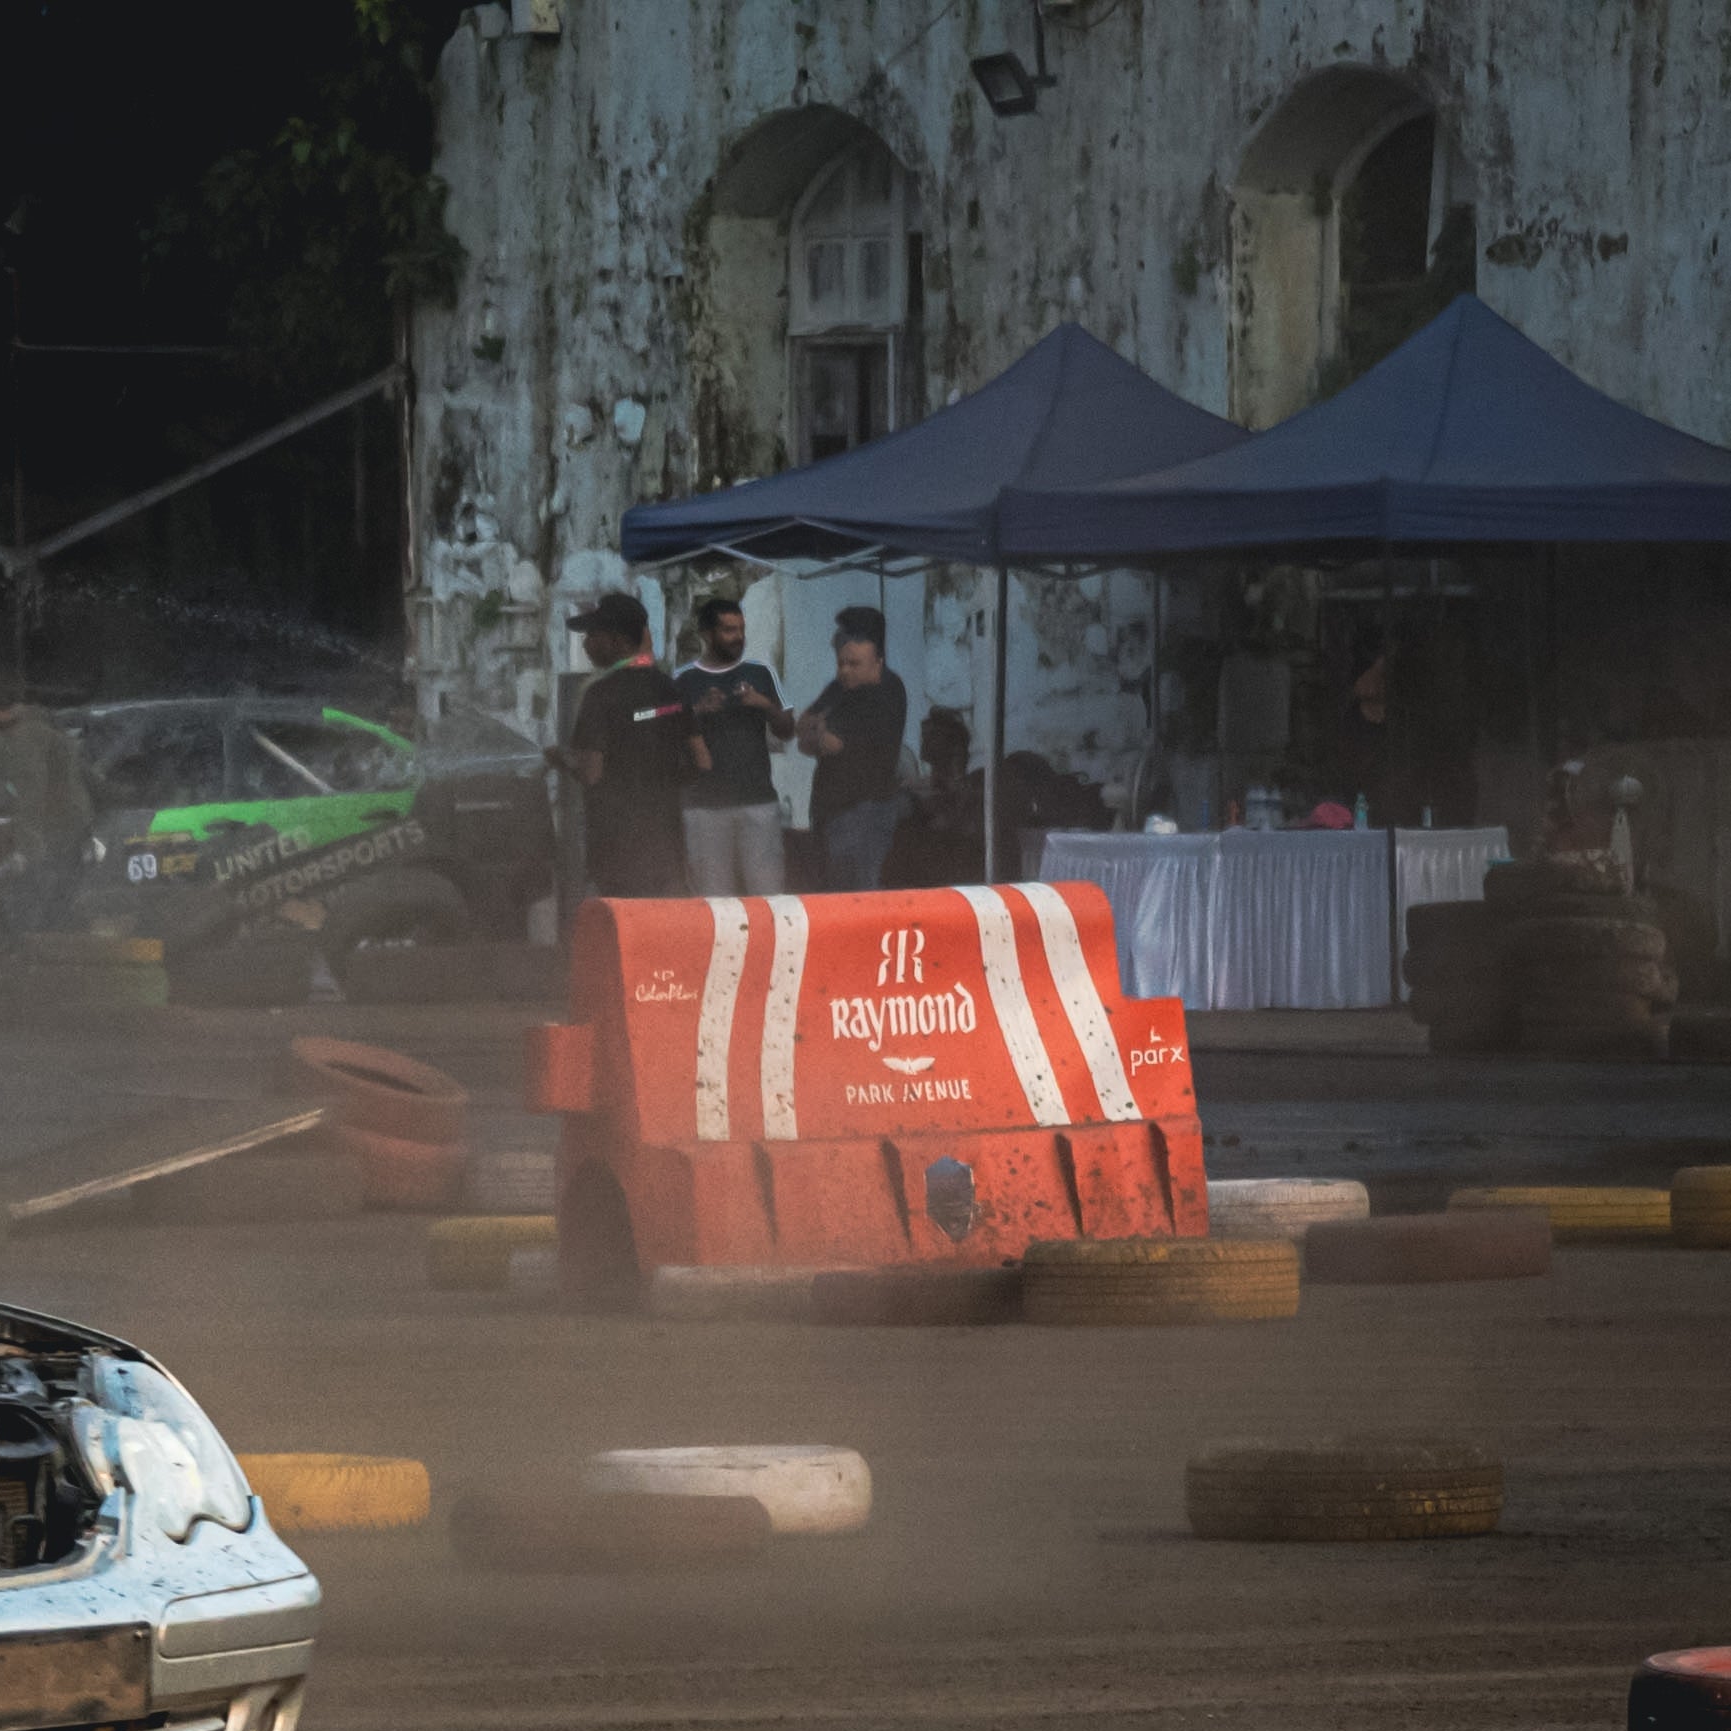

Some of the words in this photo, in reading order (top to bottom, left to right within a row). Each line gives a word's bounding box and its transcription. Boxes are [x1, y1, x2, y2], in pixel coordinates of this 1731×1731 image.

[128, 853, 158, 883] 69
[213, 824, 312, 882] UNITED
[829, 981, 977, 1053] Raymond
[1130, 1046, 1186, 1077] parx
[845, 1083, 895, 1106] PARK
[902, 1078, 973, 1103] AVENUE
